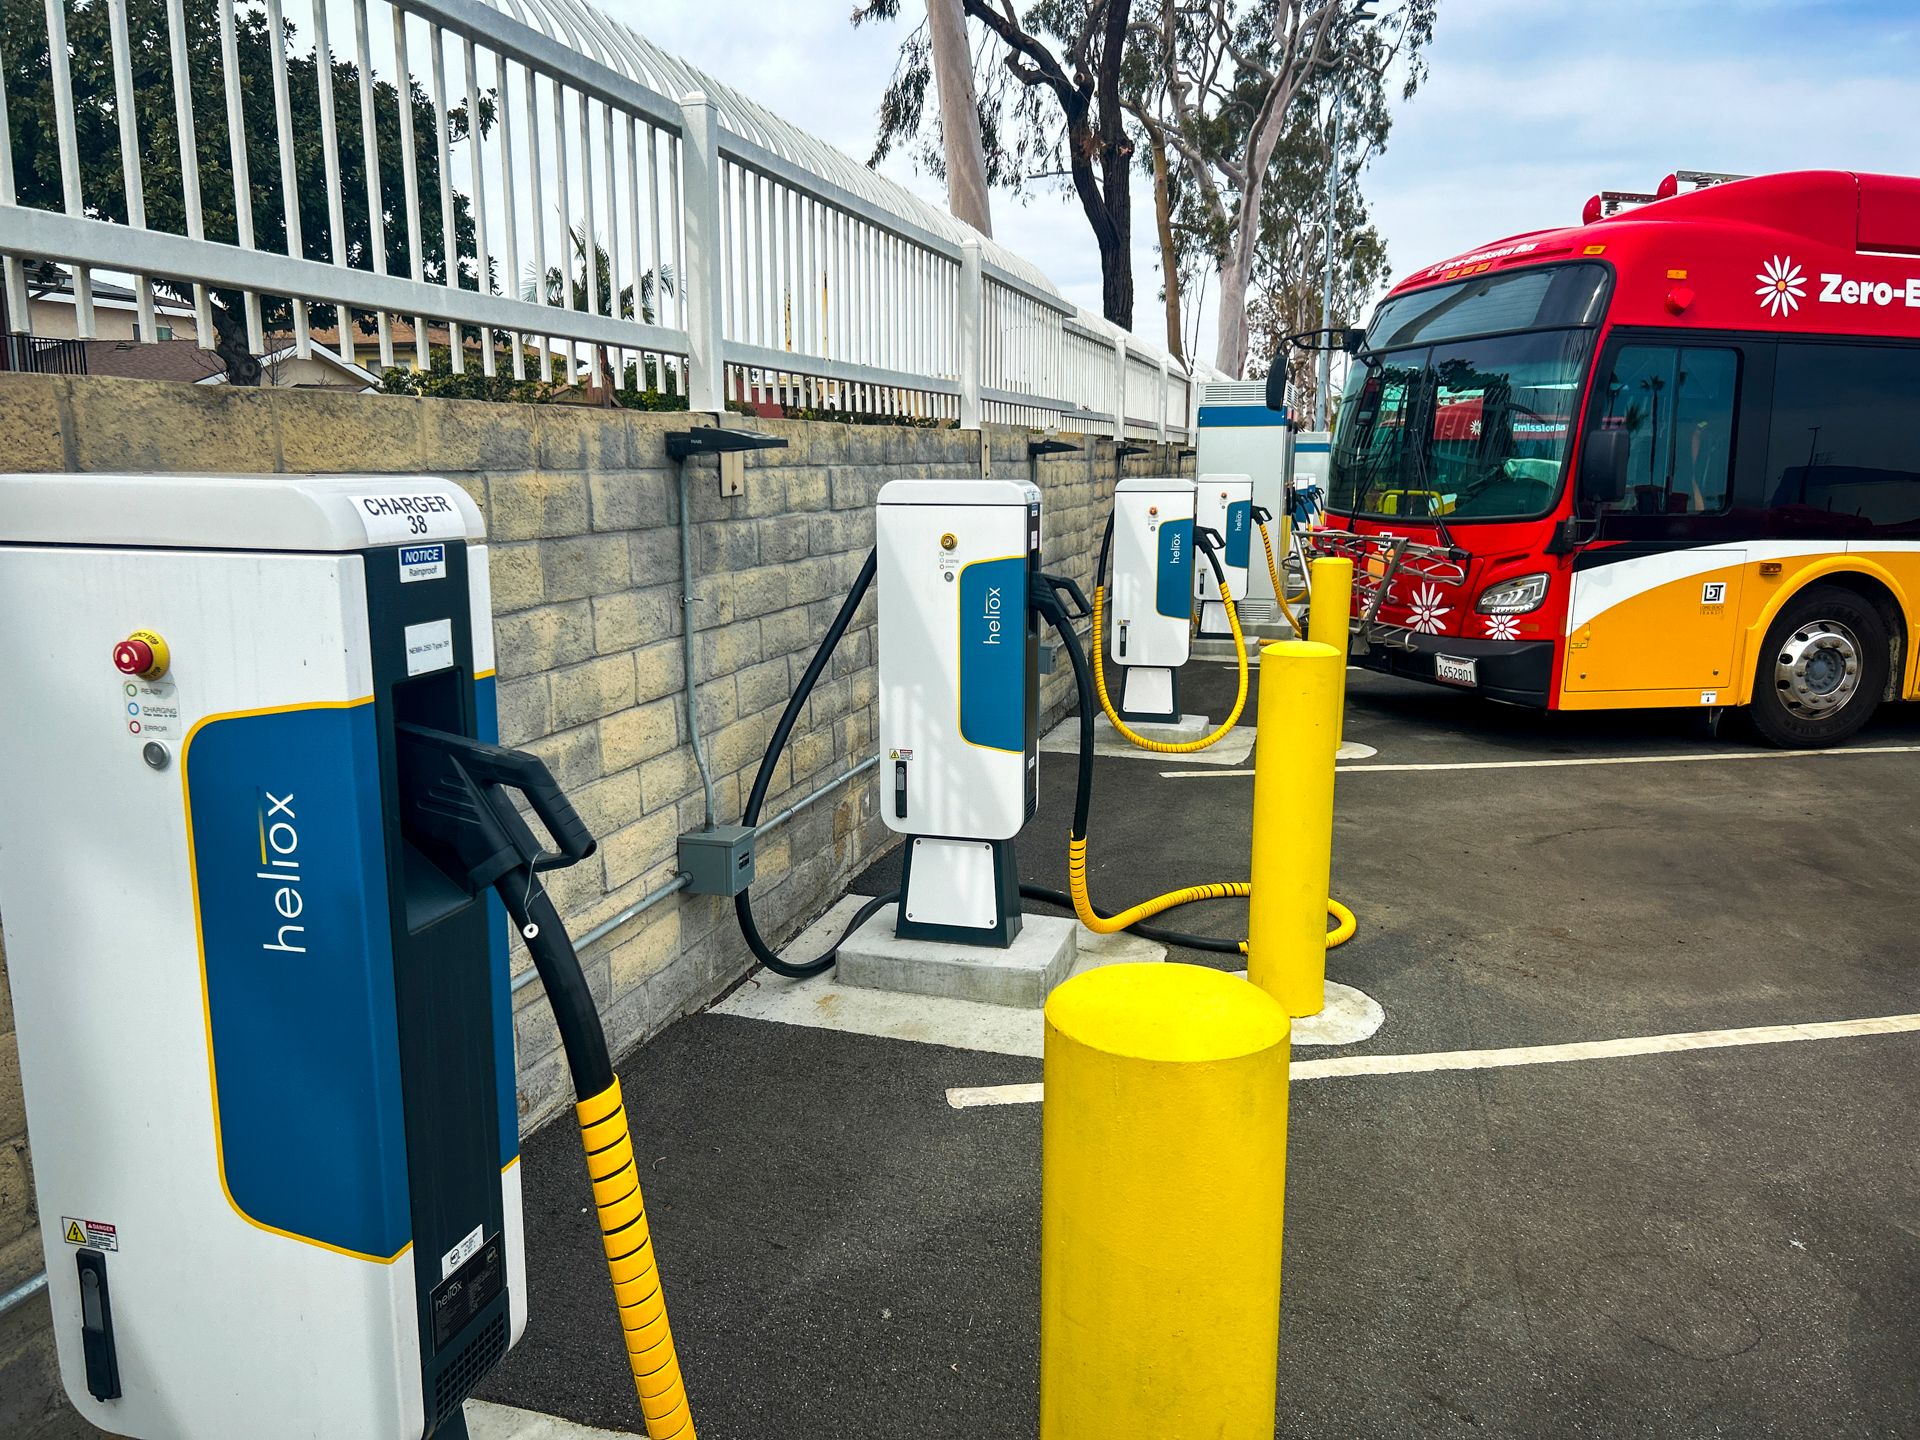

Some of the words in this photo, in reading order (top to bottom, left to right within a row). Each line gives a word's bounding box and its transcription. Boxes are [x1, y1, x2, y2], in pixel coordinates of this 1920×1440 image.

[1819, 272, 1920, 308] Zero-E
[363, 495, 452, 516] CHARGER
[407, 515, 428, 534] 38
[404, 549, 439, 563] NOTICE
[1170, 533, 1181, 564] heliox
[409, 565, 438, 577] Rainproof
[983, 587, 1001, 645] heliox
[1438, 664, 1474, 683] 1652801
[142, 706, 177, 714] CHARGING
[144, 724, 168, 732] ERROR
[257, 791, 306, 953] heliox
[92, 1223, 114, 1232] DANGER
[435, 1281, 463, 1311] heliox
